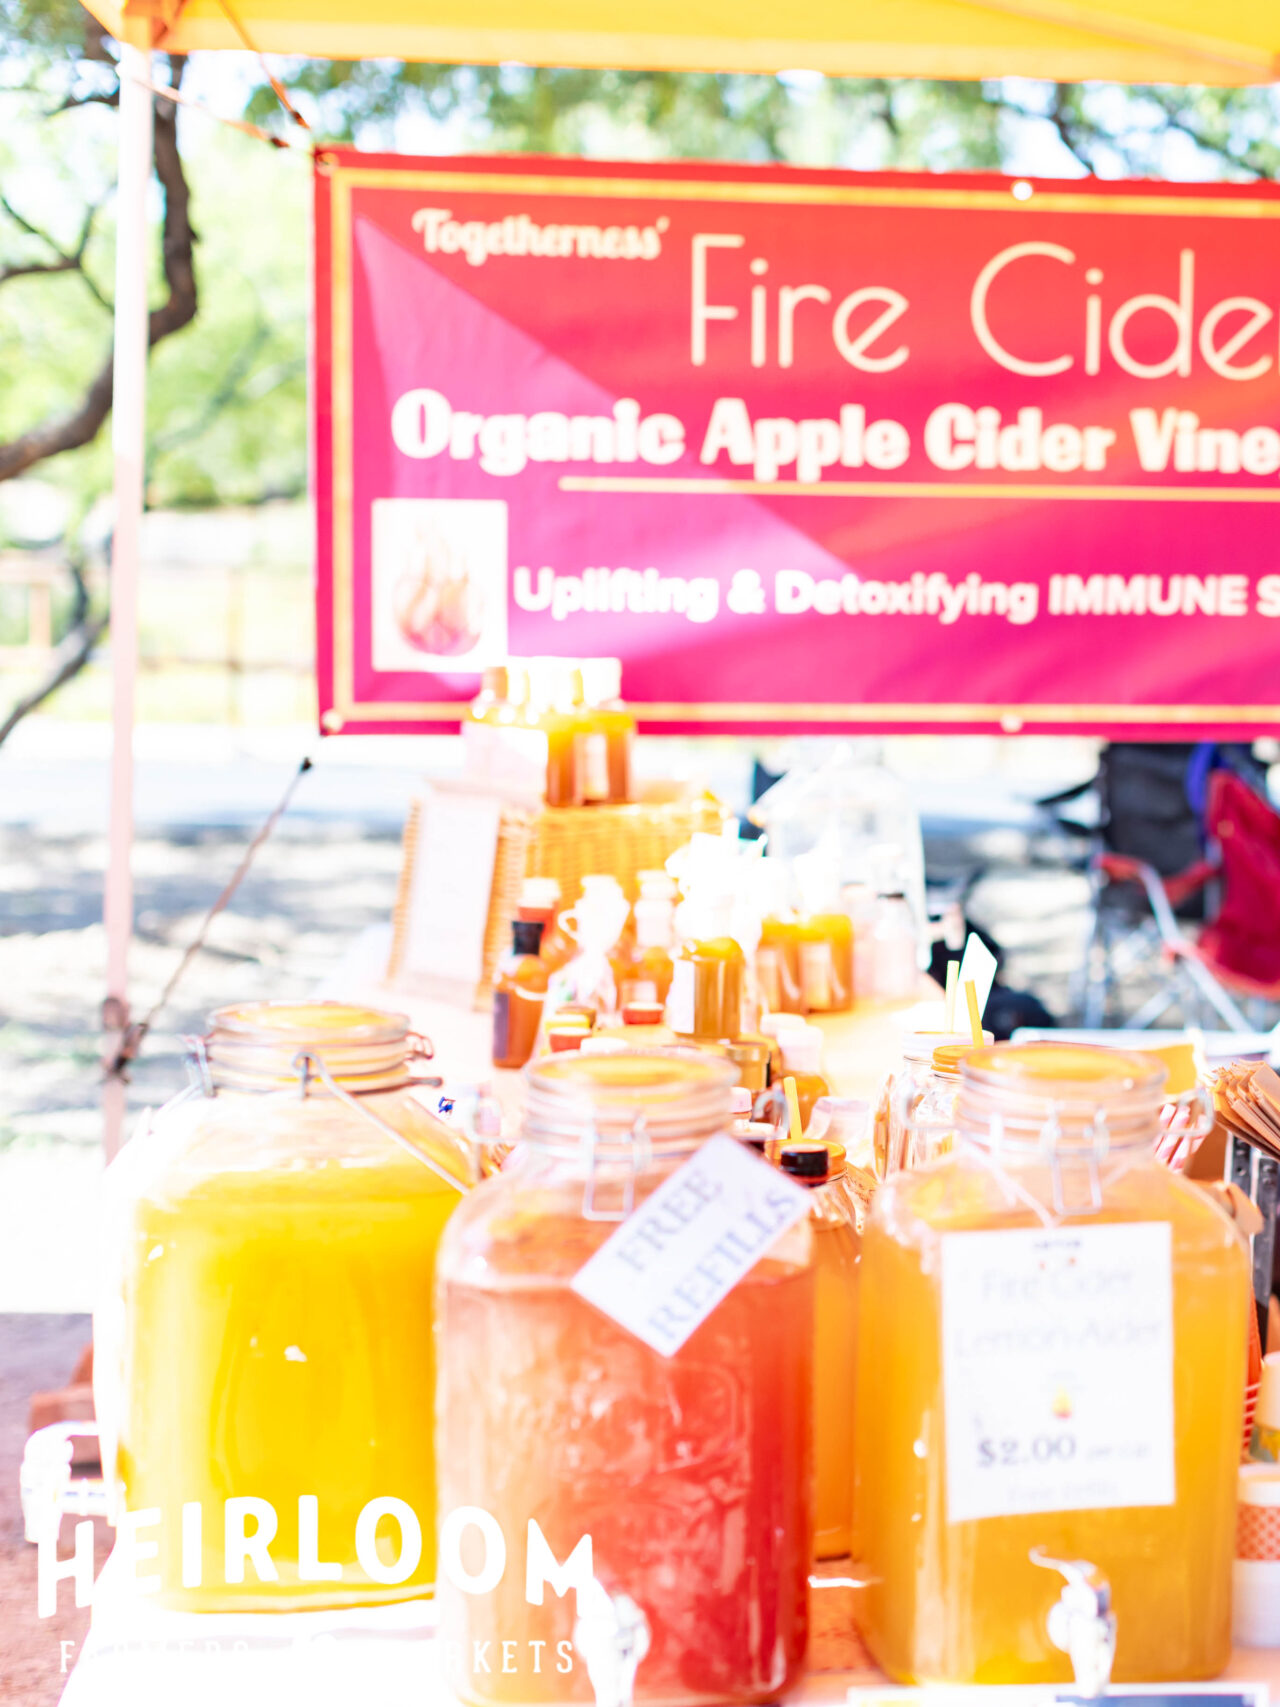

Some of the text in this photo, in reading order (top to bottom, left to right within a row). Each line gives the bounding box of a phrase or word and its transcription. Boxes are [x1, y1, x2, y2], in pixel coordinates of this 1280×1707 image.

[690, 233, 910, 373] Fire
[391, 388, 686, 477] Organic
[700, 398, 910, 484] Apple
[924, 402, 1115, 472] Cider
[512, 565, 720, 623] Uplifting
[726, 568, 767, 615] &
[774, 569, 1040, 624] Detoxifying
[1048, 573, 1249, 616] IMMUNE
[615, 1167, 723, 1272] FREE
[648, 1187, 797, 1340] REFILLS
[977, 1434, 1077, 1468] $2.00
